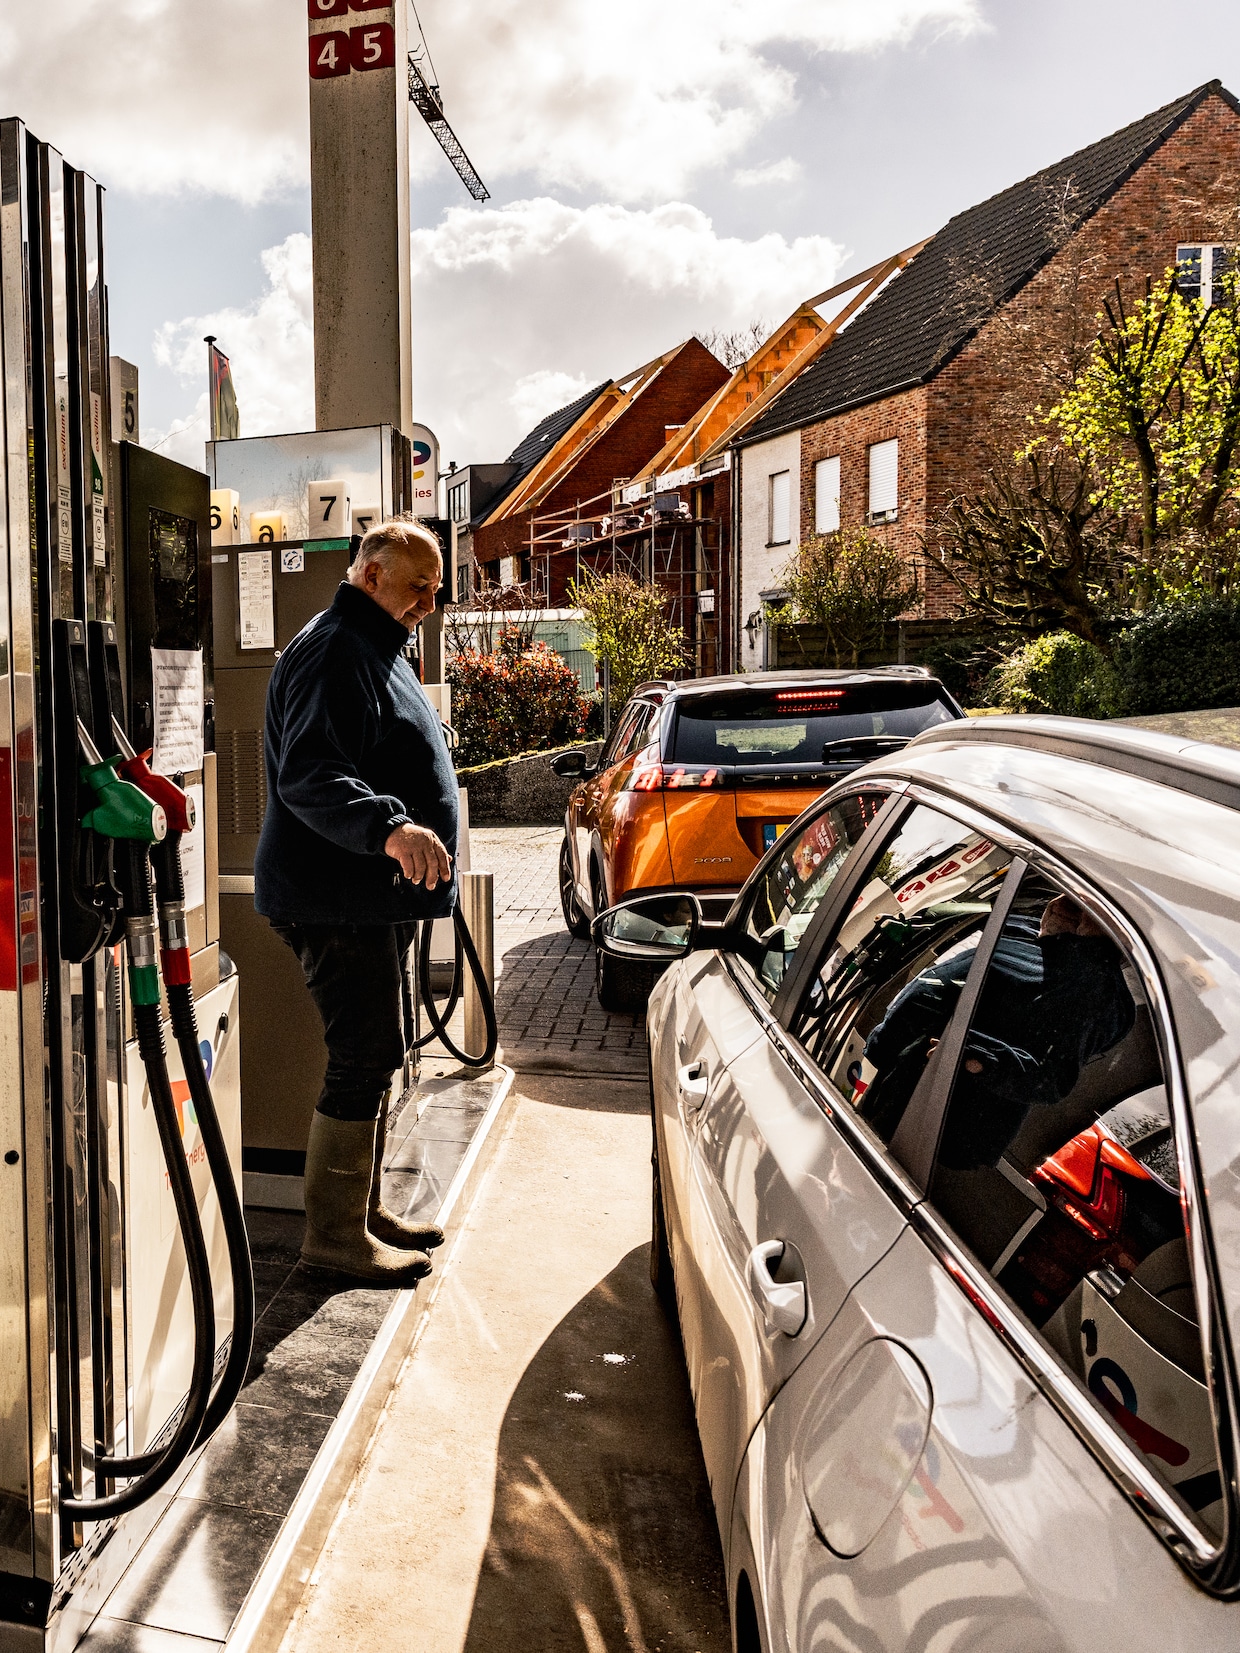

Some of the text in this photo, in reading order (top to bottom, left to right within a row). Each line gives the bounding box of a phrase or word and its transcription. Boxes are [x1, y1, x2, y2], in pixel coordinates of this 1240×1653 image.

[317, 31, 382, 69] 4 5
[124, 391, 135, 434] 5
[210, 505, 222, 530] 6
[320, 496, 336, 521] 7
[774, 773, 837, 781] PEUG
